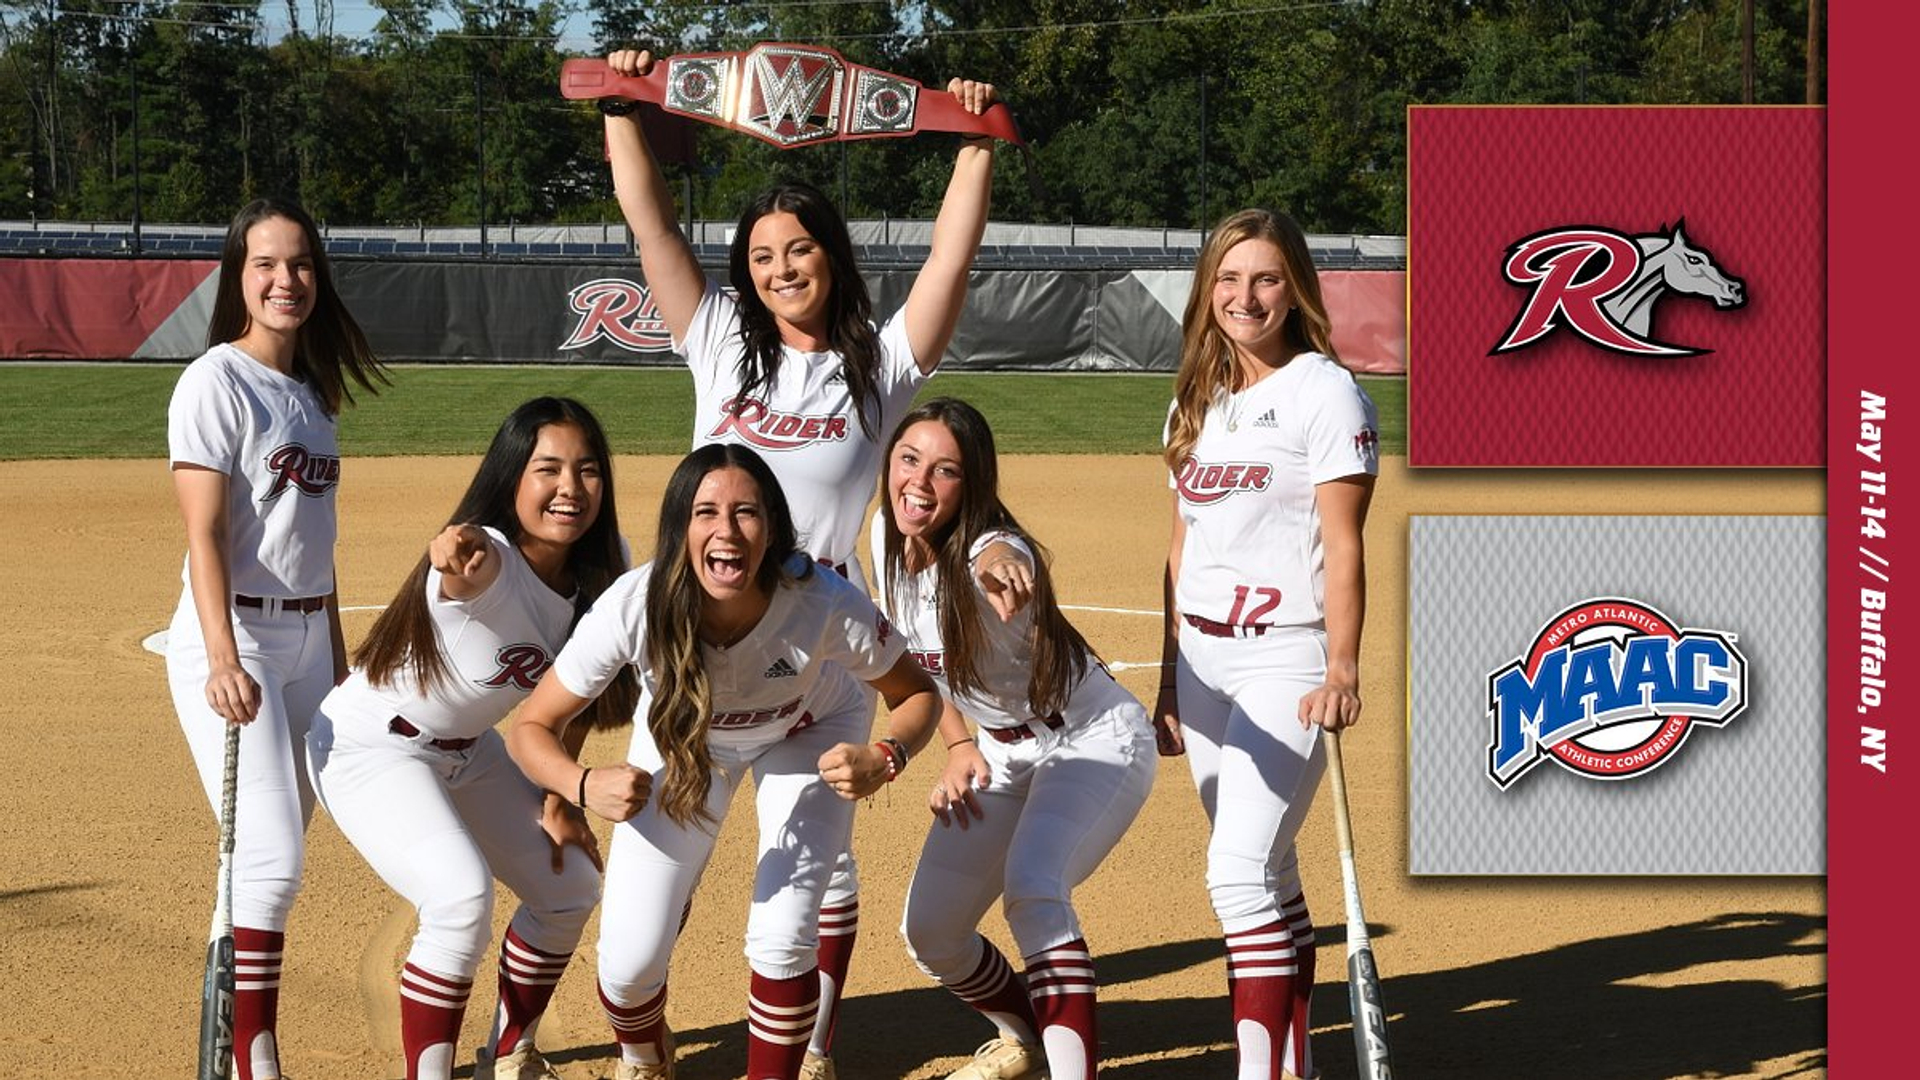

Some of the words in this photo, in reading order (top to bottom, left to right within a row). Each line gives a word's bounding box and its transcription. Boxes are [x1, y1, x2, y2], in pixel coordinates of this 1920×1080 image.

[704, 394, 850, 450] RIDER
[259, 441, 341, 502] RIDE
[1227, 584, 1283, 628] 12
[763, 670, 799, 679] adidas
